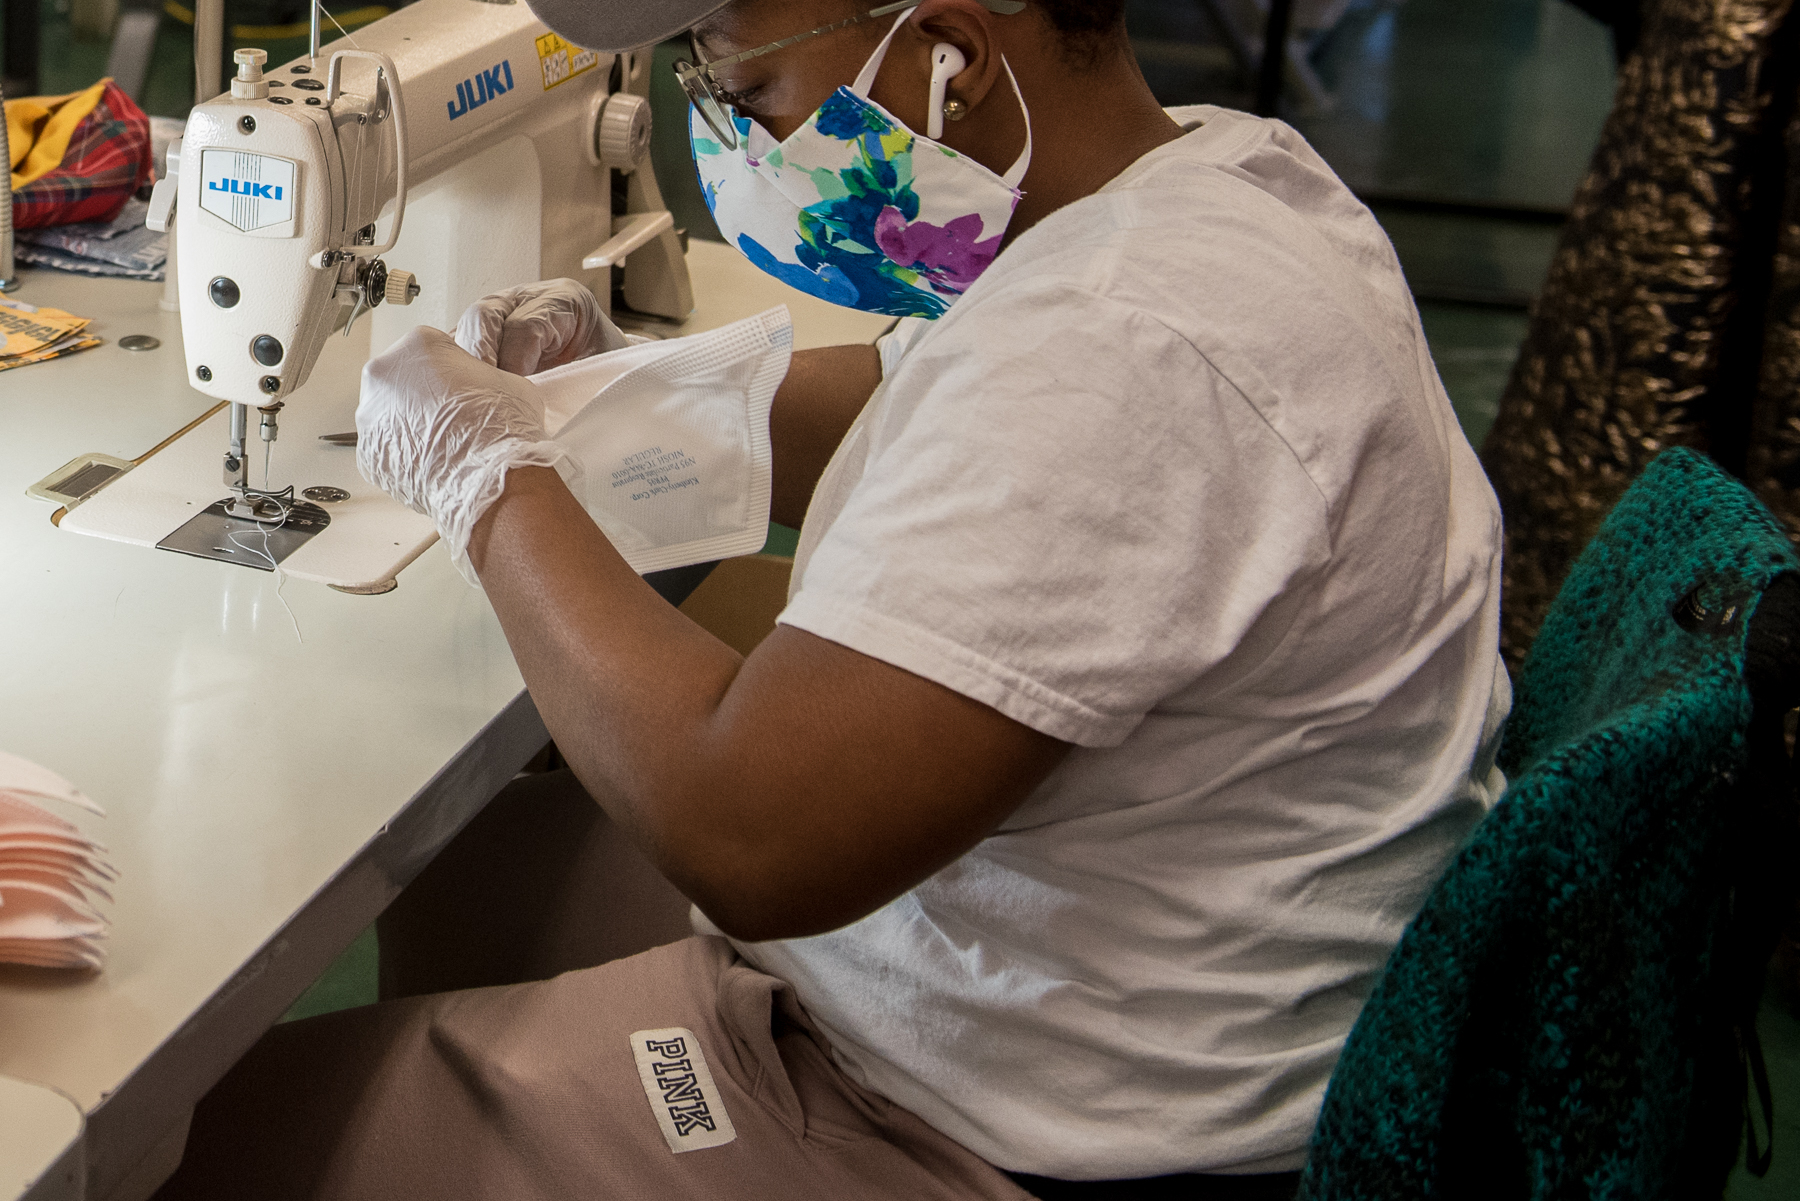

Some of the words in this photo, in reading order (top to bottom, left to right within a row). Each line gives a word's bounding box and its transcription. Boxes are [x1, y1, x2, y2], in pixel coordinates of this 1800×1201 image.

[447, 59, 515, 122] JUKI
[209, 177, 283, 201] JUKI
[622, 445, 662, 466] REGULAR
[657, 448, 685, 465] NIOSH
[681, 456, 697, 469] N95
[645, 1036, 717, 1137] PINK
